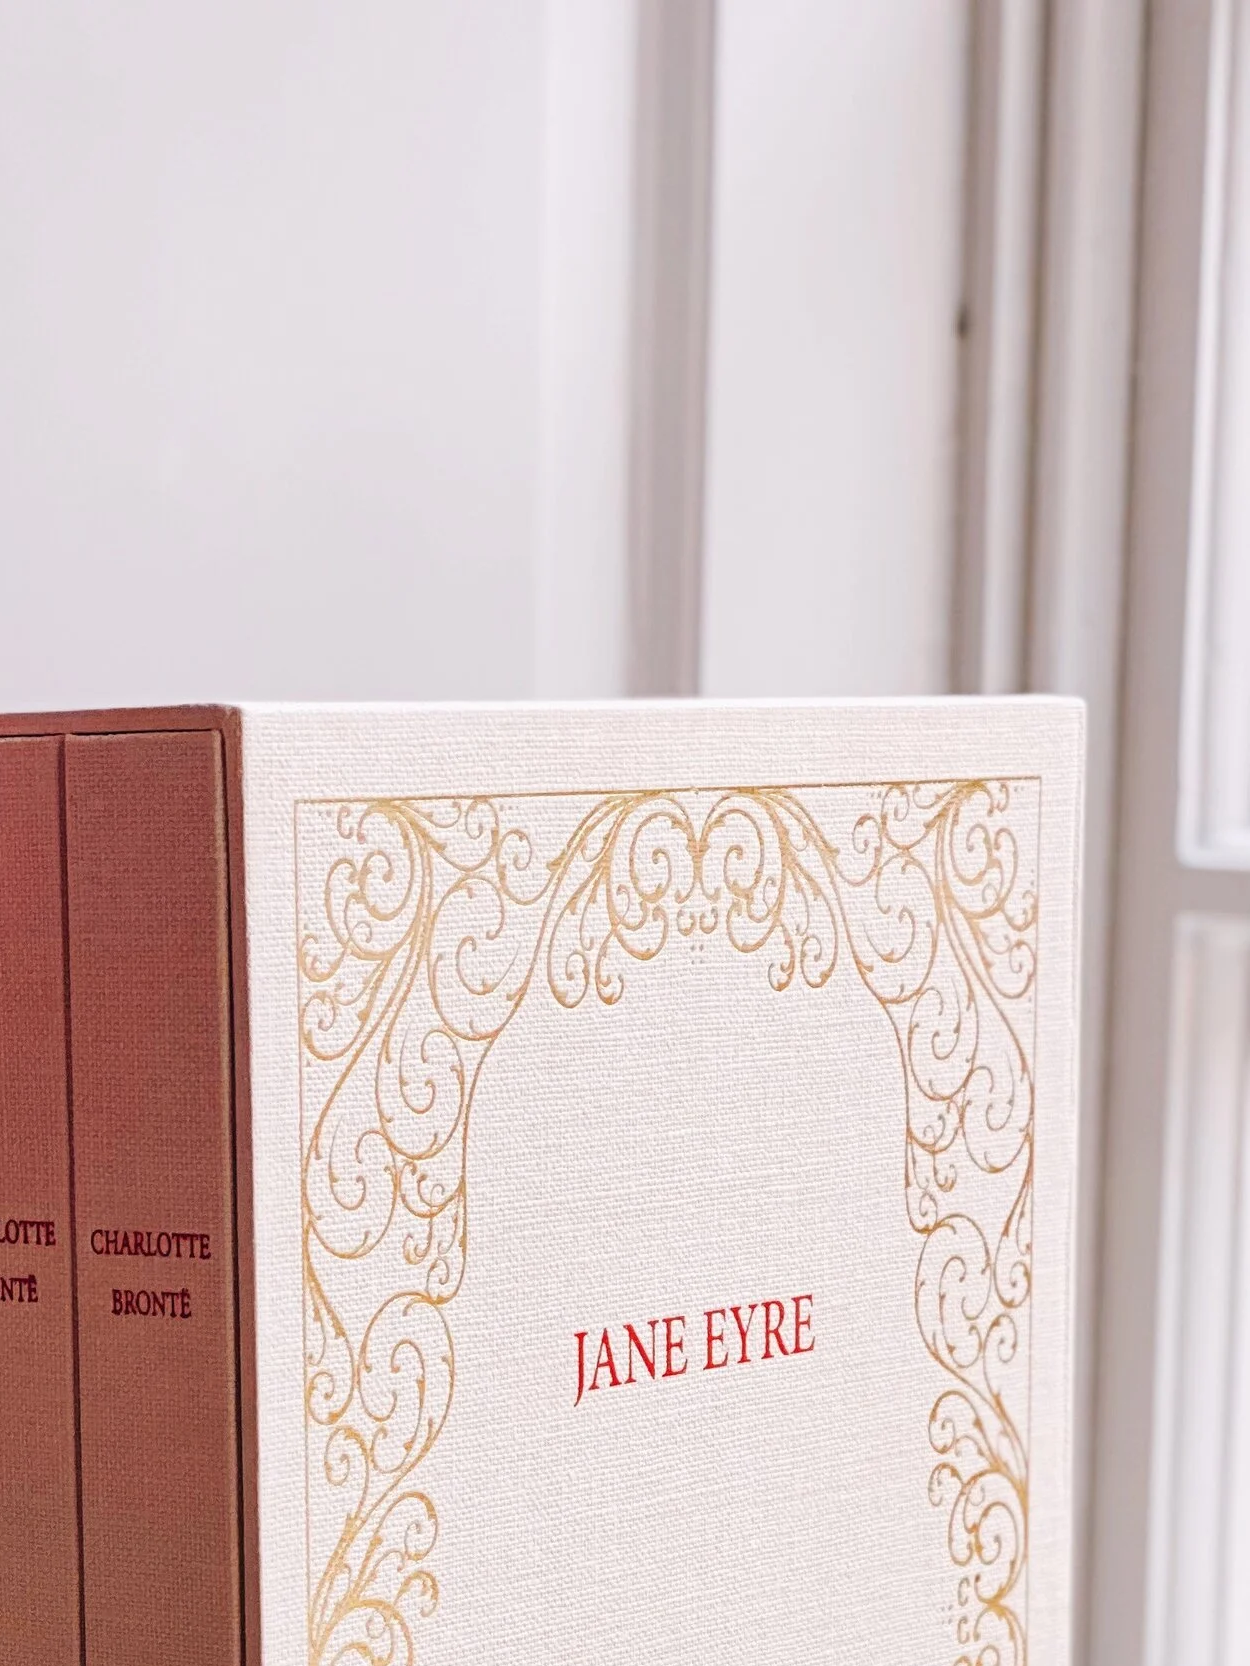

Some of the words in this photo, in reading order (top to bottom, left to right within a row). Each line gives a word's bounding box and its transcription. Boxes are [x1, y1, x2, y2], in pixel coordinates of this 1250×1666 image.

[91, 1229, 211, 1260] CHARLOTTE
[111, 1288, 192, 1319] BRONTË
[573, 1315, 688, 1407] JANE
[703, 1294, 816, 1370] EYRE
